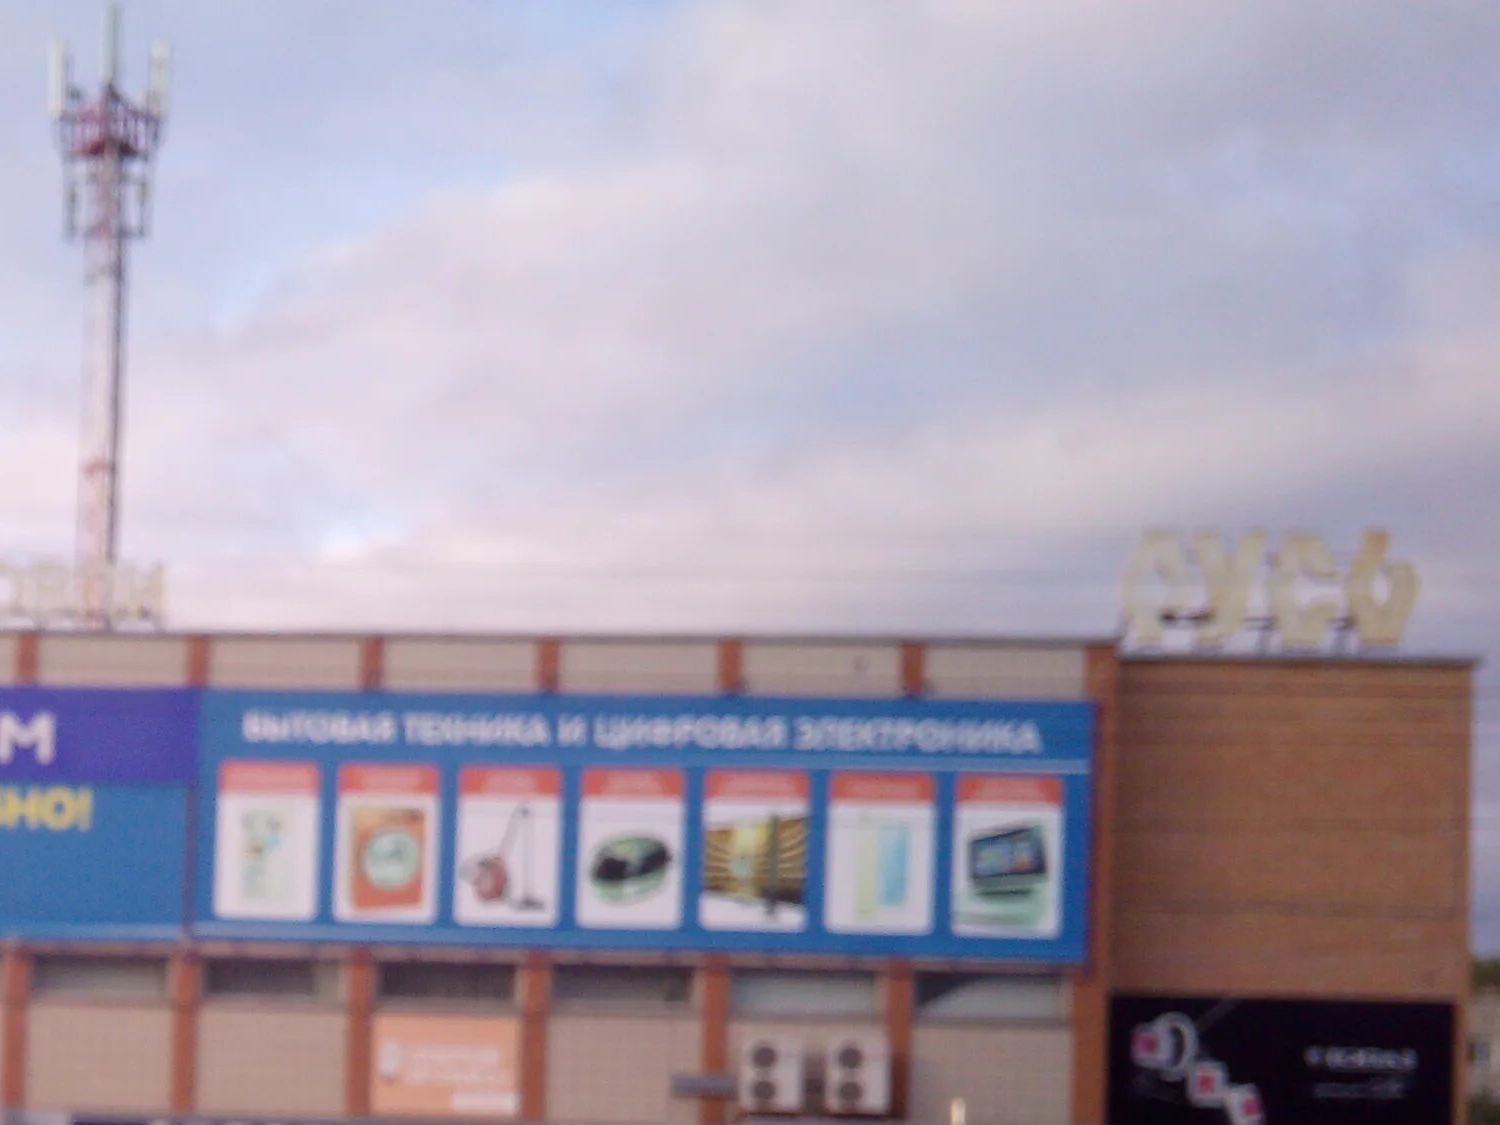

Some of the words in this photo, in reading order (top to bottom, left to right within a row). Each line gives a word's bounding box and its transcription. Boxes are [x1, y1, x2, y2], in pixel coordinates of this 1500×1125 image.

[242, 711, 396, 744] БЫТОВАЯ
[404, 714, 550, 746] ТЕХНИКА
[557, 716, 588, 746] И
[594, 714, 787, 752] ЦИФРОВАЯ
[794, 717, 1043, 753] ЭЛЕКТРОНИКА
